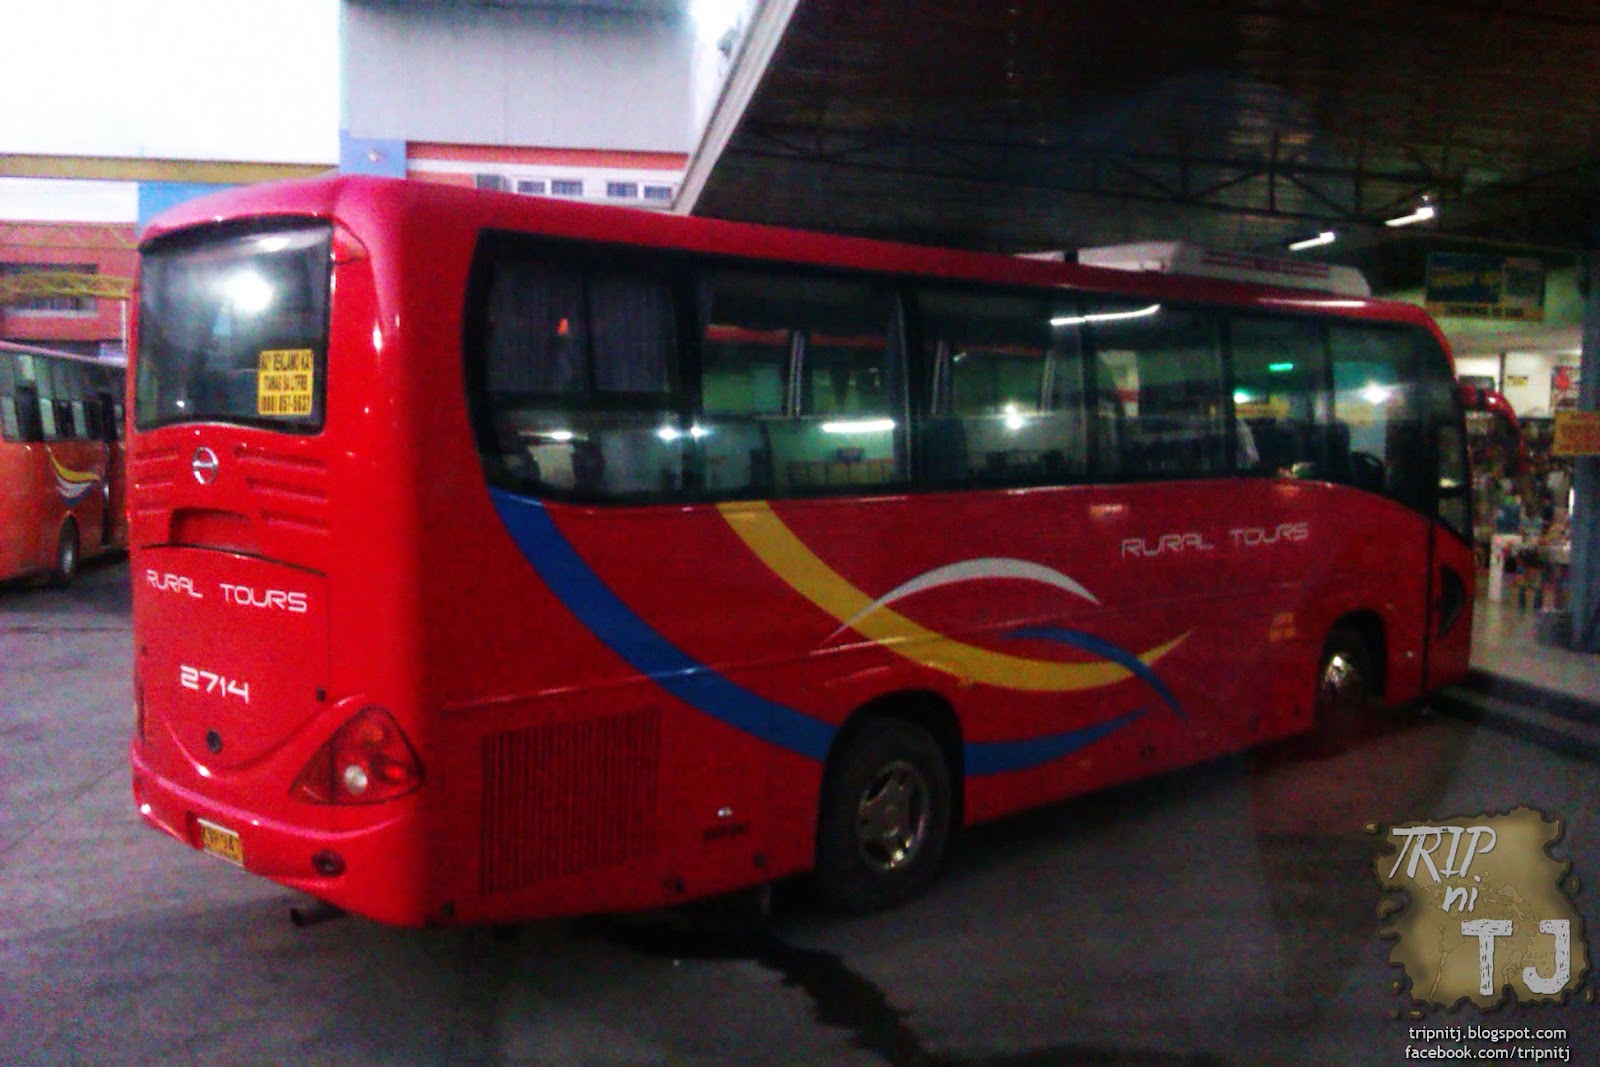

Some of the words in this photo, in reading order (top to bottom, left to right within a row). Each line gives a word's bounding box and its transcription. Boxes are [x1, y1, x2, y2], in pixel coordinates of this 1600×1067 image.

[1121, 532, 1215, 560] RURAL
[1229, 521, 1309, 546] TOURS
[146, 569, 203, 599] RURAL
[219, 582, 308, 614] TOURS
[180, 664, 250, 704] 2714
